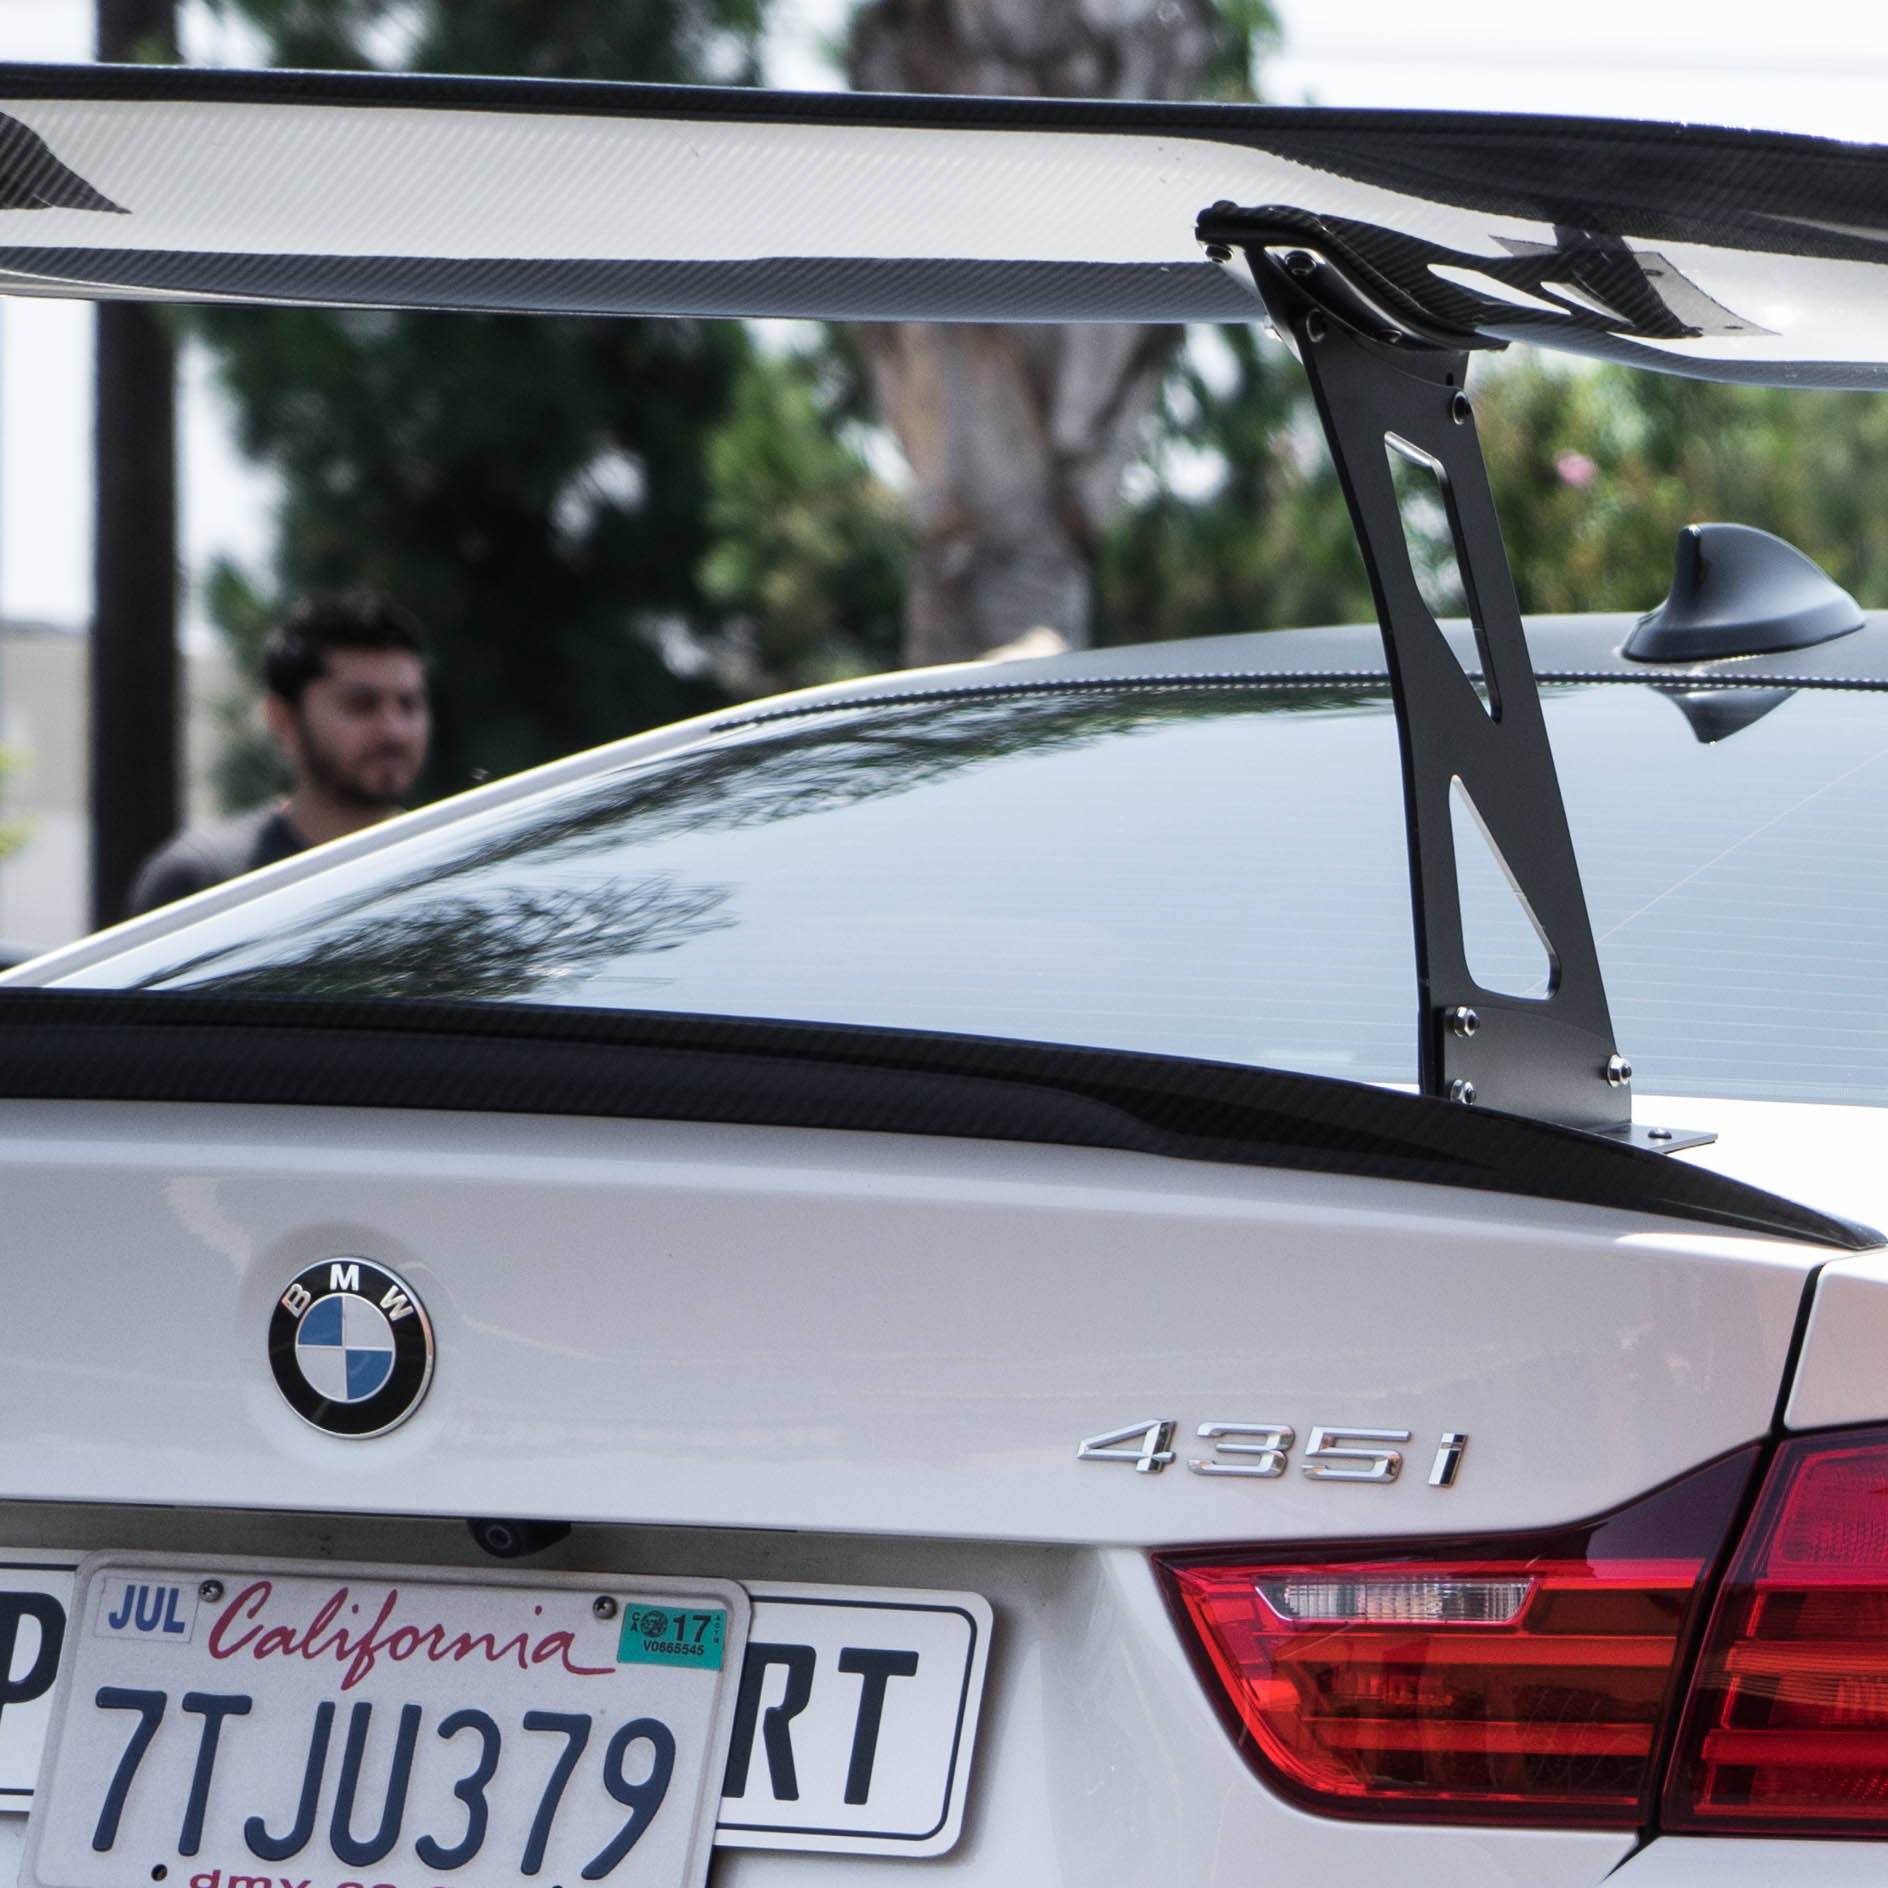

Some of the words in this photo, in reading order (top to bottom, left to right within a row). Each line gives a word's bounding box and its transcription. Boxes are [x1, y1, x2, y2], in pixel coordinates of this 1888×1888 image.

[281, 1264, 414, 1322] BMW
[1076, 1418, 1468, 1488] 435i
[108, 1584, 186, 1634] JUL
[208, 1580, 617, 1691] California
[672, 1614, 712, 1643] 17
[92, 1686, 676, 1880] 7TJU379
